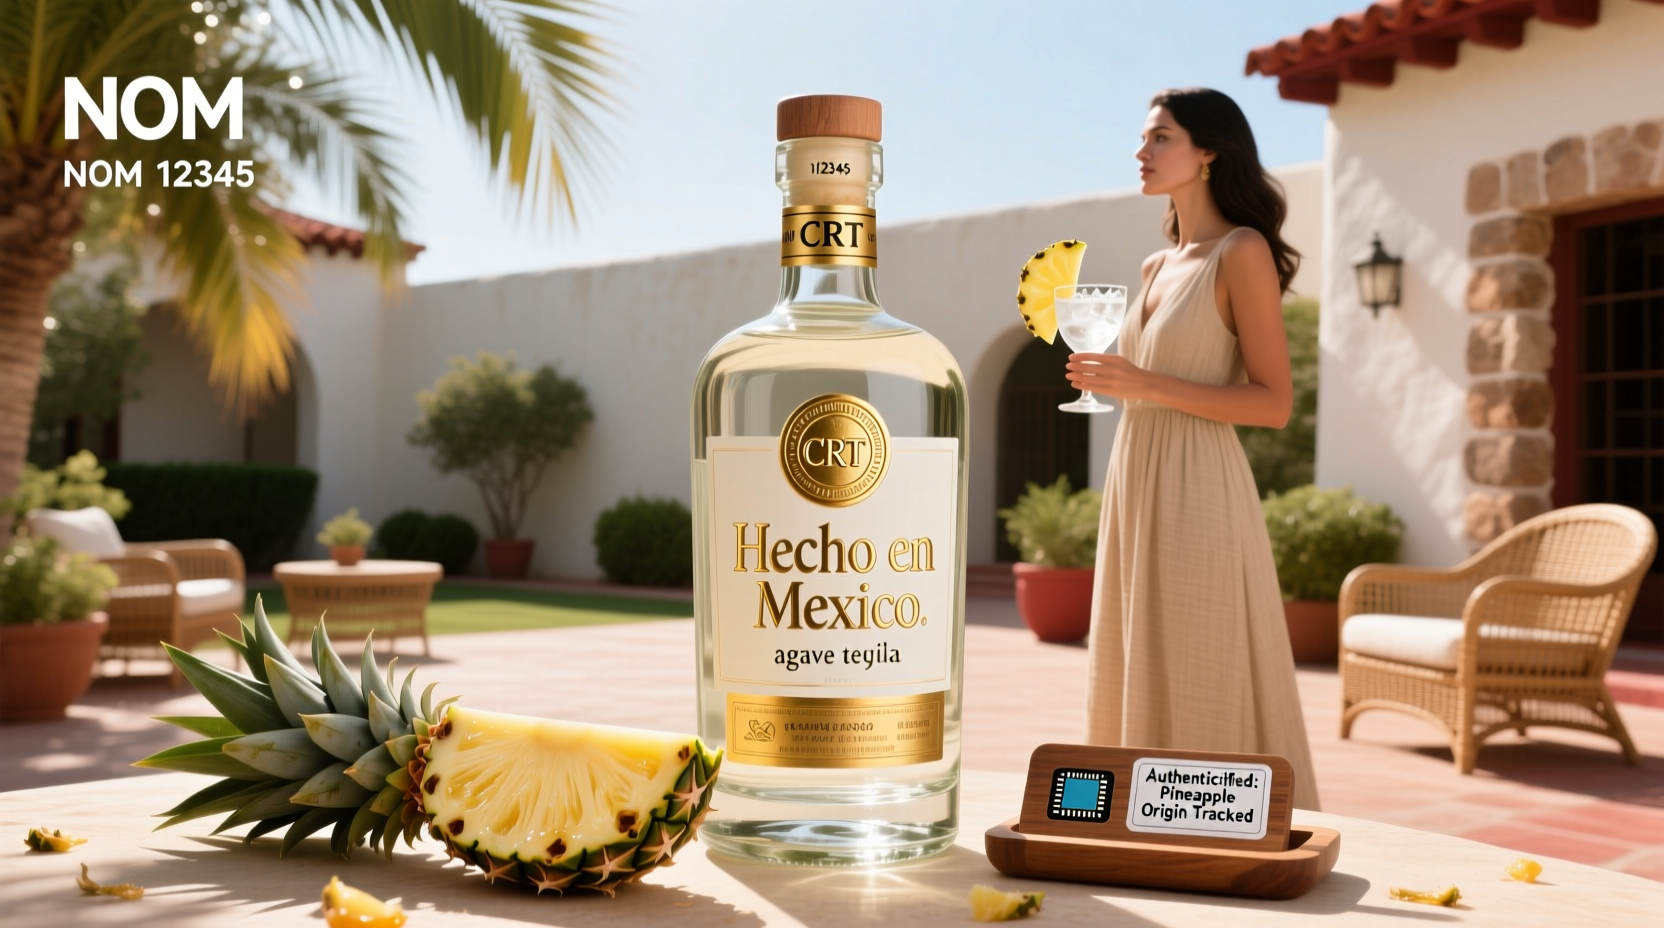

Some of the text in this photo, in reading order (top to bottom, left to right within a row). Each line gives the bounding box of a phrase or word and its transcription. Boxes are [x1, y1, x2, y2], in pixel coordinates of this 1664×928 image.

[800, 220, 863, 248] CRT
[802, 437, 866, 468] CRT
[733, 522, 936, 574] Hecho en
[774, 648, 835, 671] agave
[1160, 785, 1236, 807] Pineapple
[1141, 802, 1254, 823] Origin Tracked
